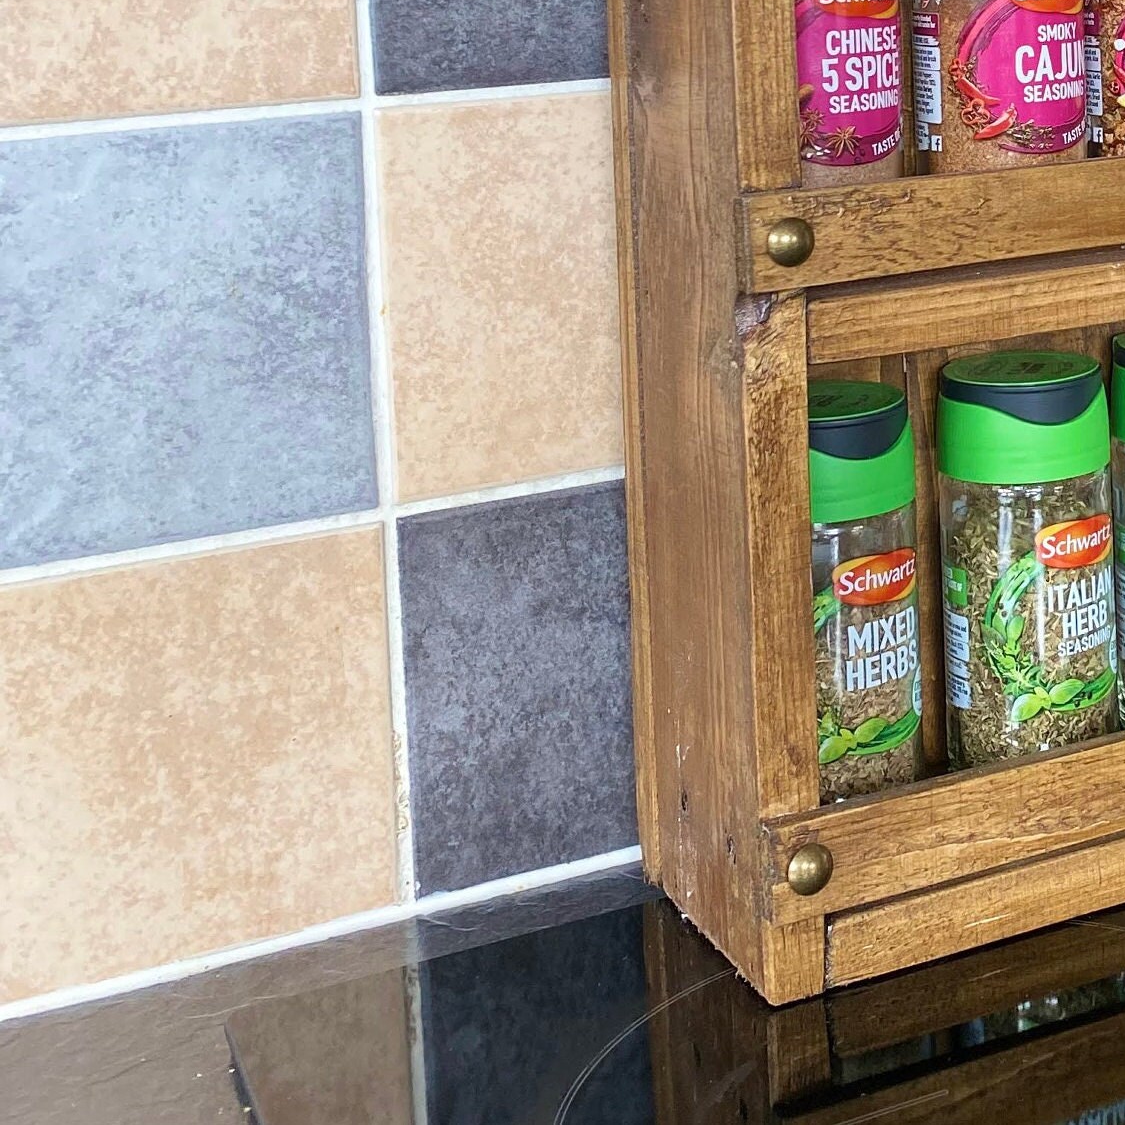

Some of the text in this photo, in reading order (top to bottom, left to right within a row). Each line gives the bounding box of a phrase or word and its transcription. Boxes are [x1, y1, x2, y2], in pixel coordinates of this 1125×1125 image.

[826, 26, 897, 55] CHINESE
[1037, 22, 1077, 42] SMOKY
[821, 58, 839, 92] 5
[845, 54, 899, 91] SPICE
[1015, 40, 1085, 83] CAJUN
[829, 89, 899, 115] SEASONING
[1023, 80, 1083, 103] SEASONING
[871, 134, 895, 156] TASTE
[1062, 124, 1082, 144] TASTE
[1041, 523, 1111, 559] Schwartz
[838, 557, 916, 596] Schwartz
[1047, 566, 1112, 613] ITALIAN
[848, 605, 915, 658] MIXED
[1062, 600, 1108, 639] HERB
[1057, 625, 1111, 657] SEASONING
[845, 639, 917, 692] HERBS
